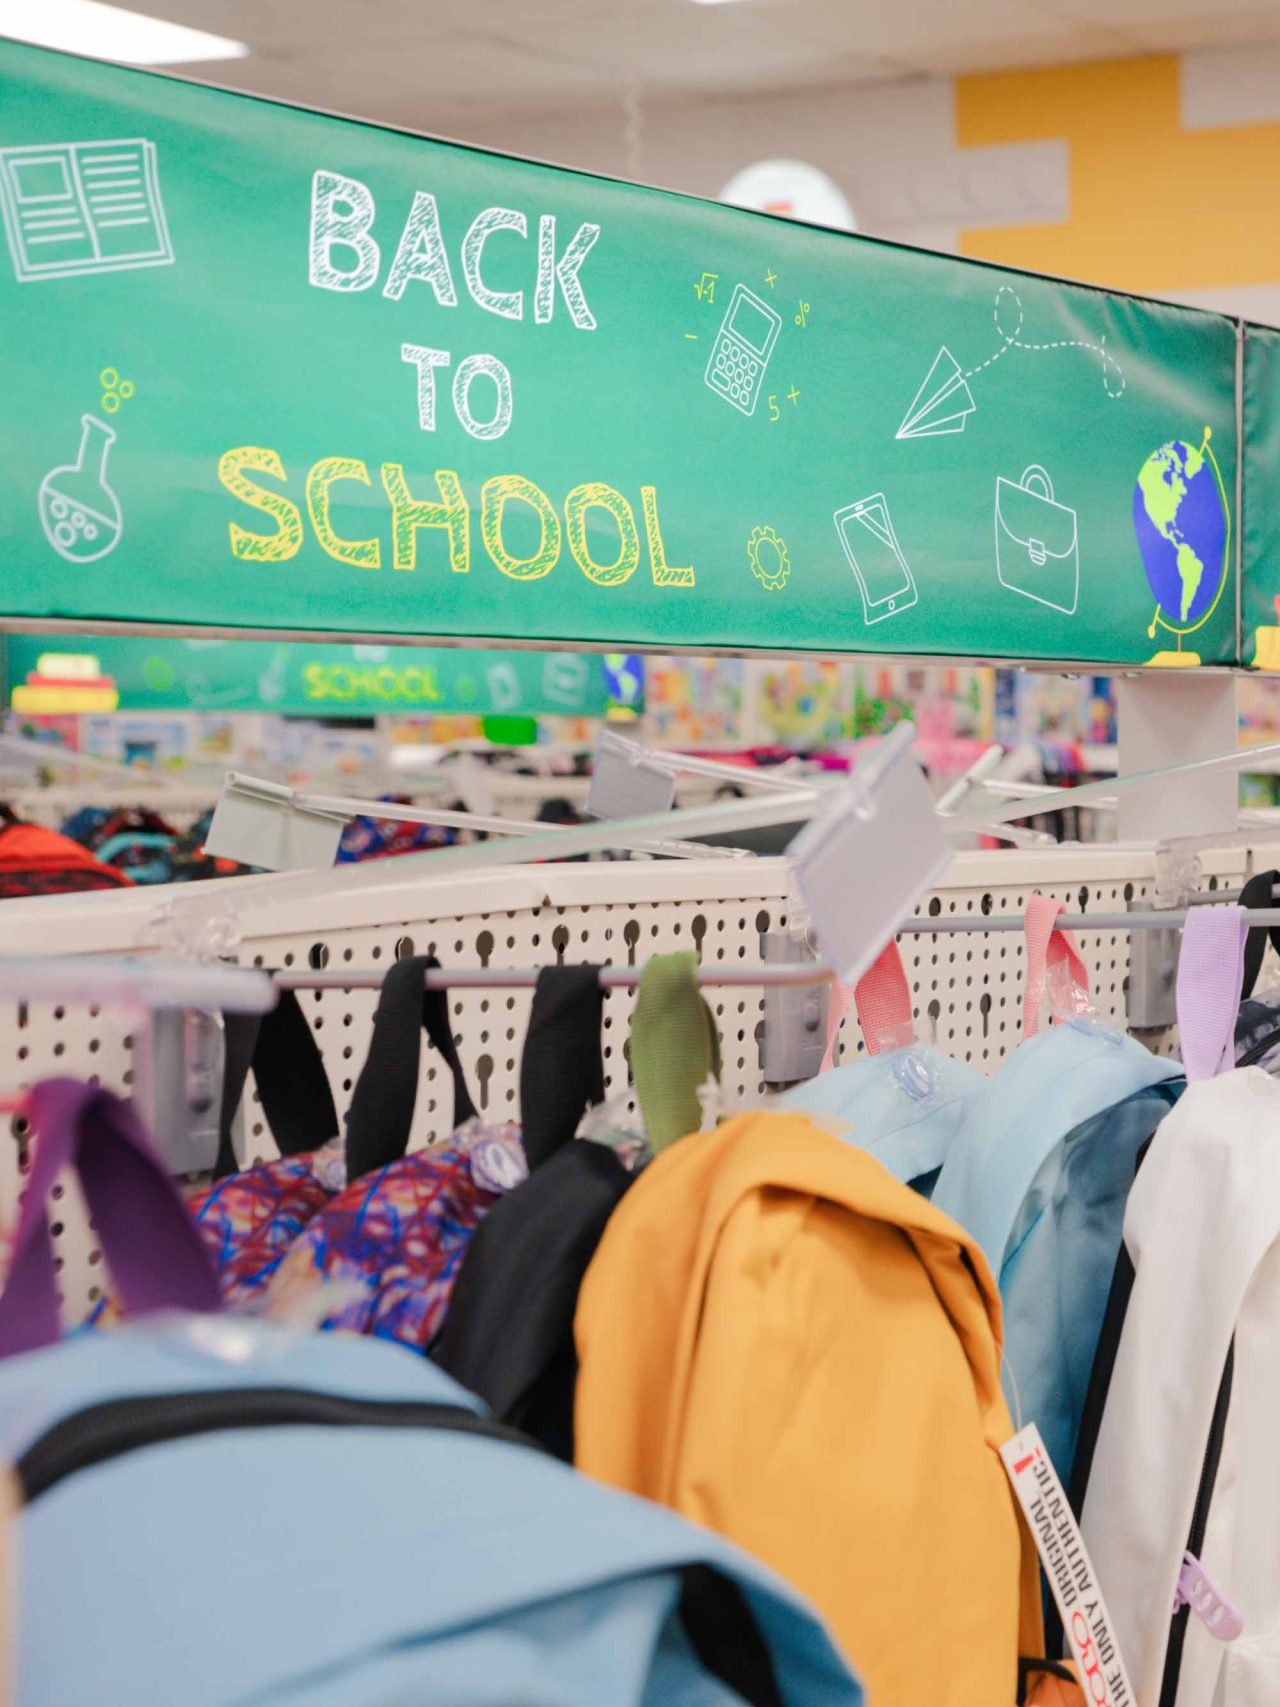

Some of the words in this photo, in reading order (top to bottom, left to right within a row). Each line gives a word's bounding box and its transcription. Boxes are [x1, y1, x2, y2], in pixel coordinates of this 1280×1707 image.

[309, 170, 601, 330] BACK
[400, 343, 513, 440] TO
[217, 446, 696, 587] SCHOOL
[303, 663, 443, 704] SCHOOL
[1029, 1496, 1077, 1608] ORIGINAL
[1072, 1610, 1112, 1707] OLO
[1085, 1601, 1115, 1666] ONLY
